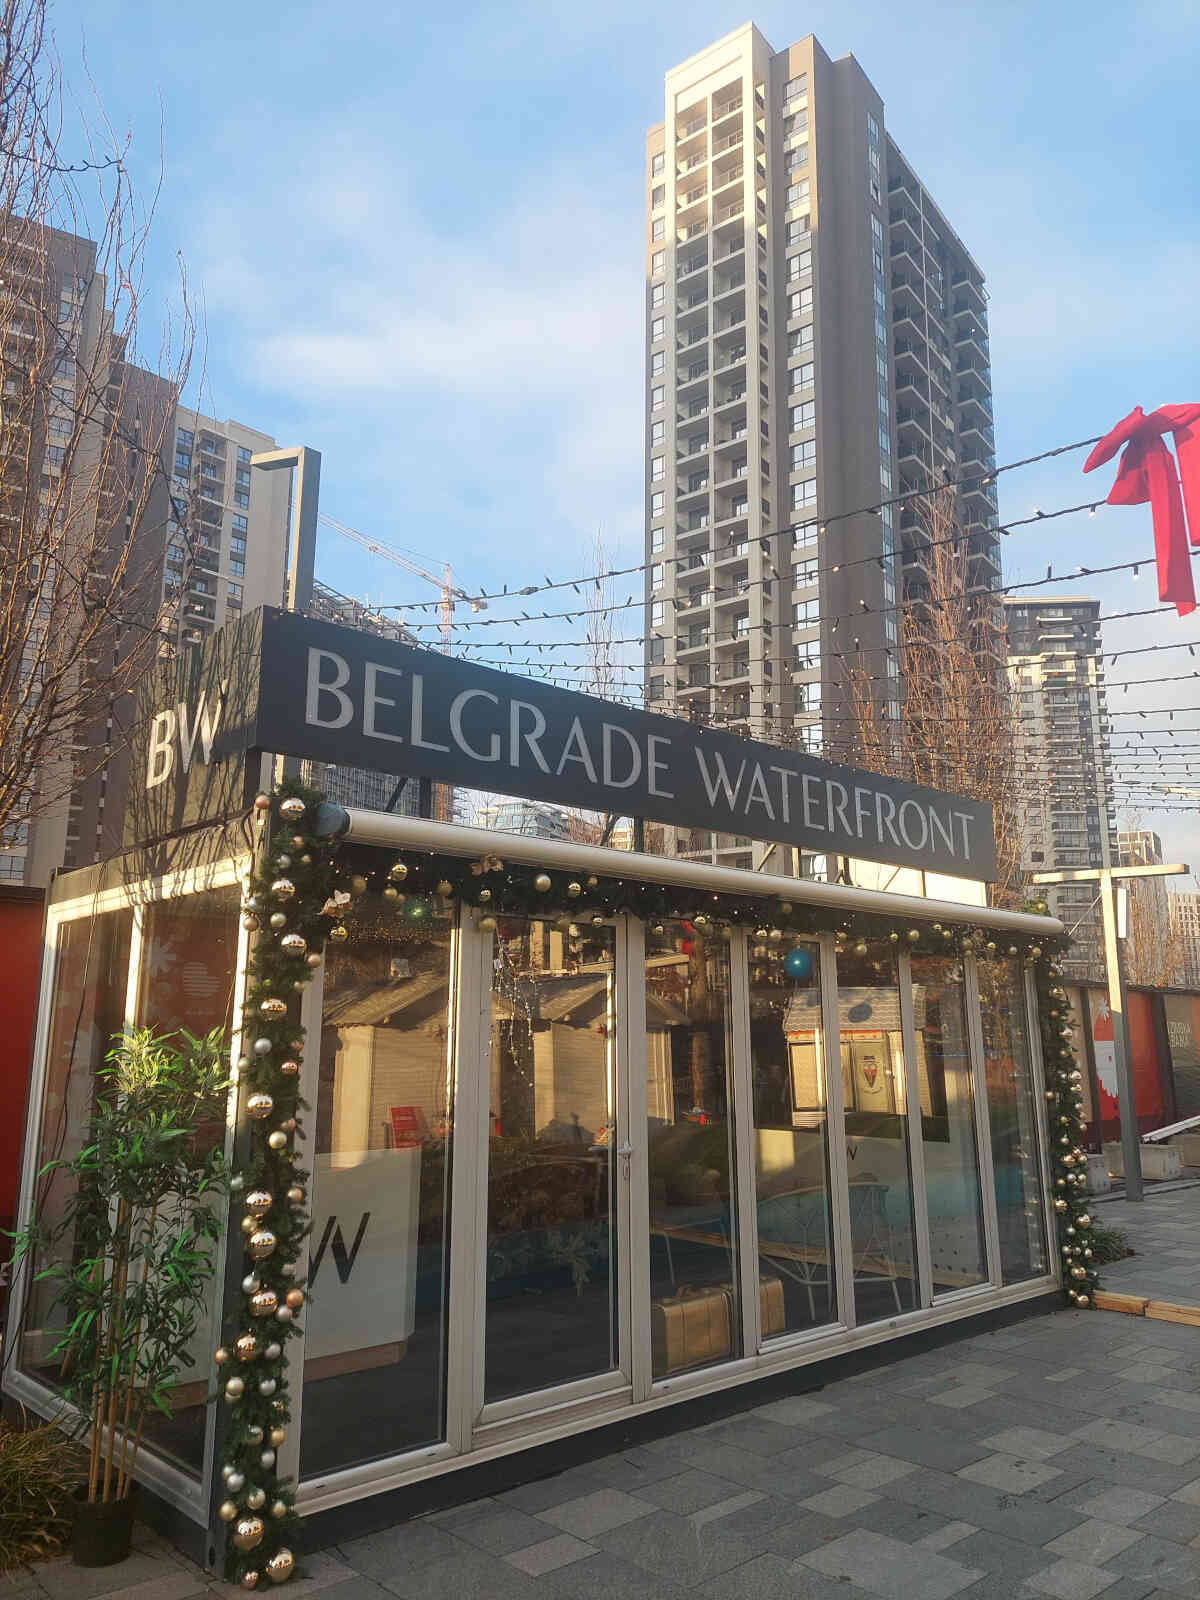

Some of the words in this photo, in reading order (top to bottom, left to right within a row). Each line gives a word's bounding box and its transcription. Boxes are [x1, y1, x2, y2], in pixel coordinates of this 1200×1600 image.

[146, 679, 228, 789] BW
[306, 647, 675, 799] BELGRADE
[695, 746, 975, 860] WATERFRONT
